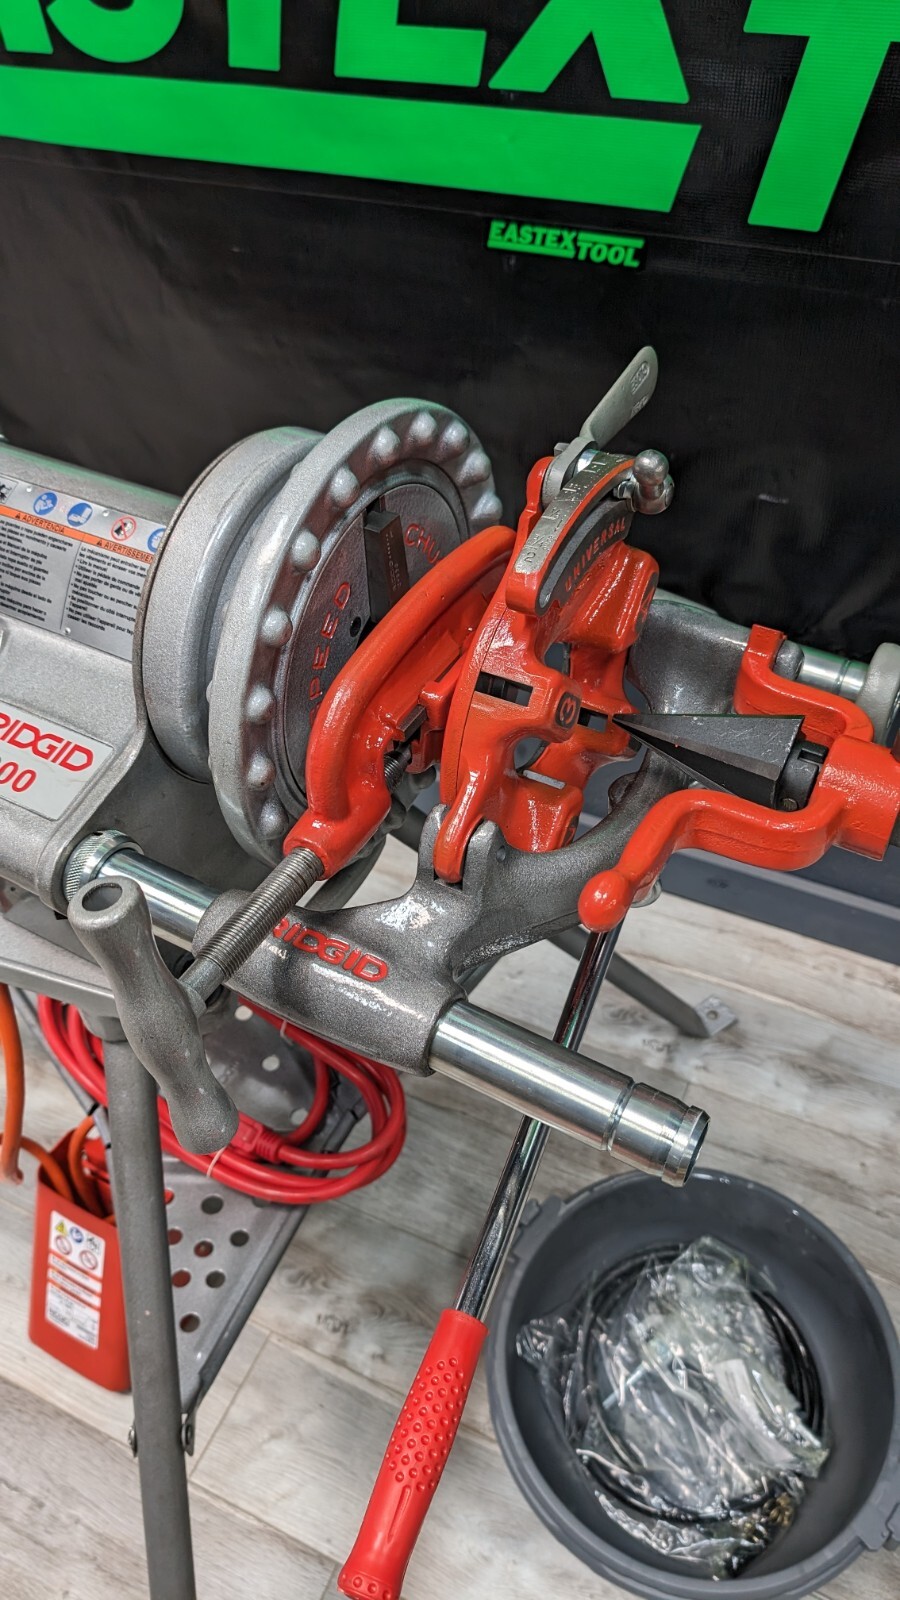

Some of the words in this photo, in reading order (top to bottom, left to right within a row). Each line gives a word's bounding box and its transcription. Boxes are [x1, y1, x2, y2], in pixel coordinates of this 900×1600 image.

[22, 514, 65, 534] ADVERTENCIA
[404, 522, 442, 565] CHU
[565, 517, 626, 592] UNIVERSAL
